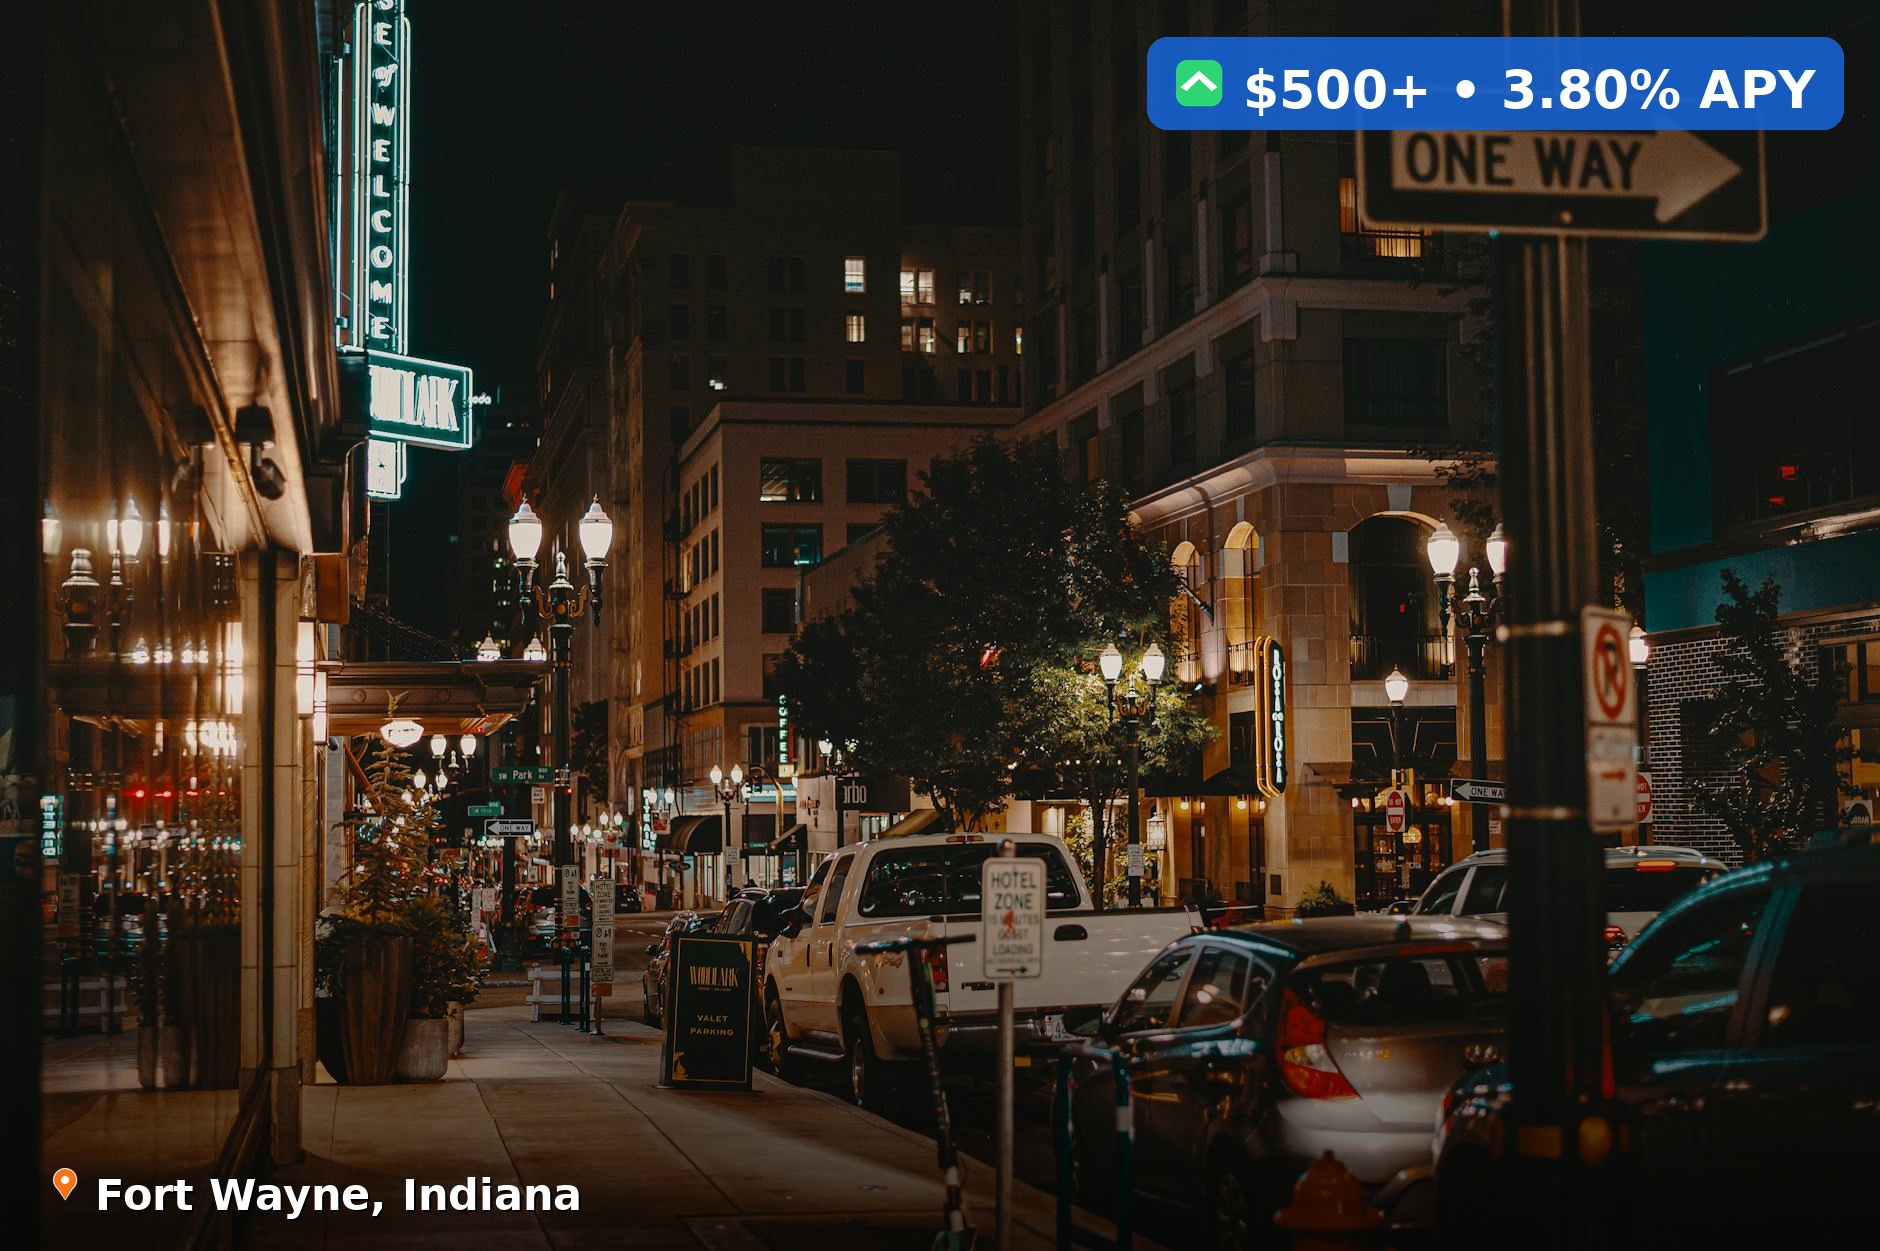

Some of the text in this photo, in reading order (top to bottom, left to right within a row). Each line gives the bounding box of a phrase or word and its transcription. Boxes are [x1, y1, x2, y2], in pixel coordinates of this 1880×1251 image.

[1406, 132, 1643, 190] ONE WAY
[371, 103, 396, 340] WELCOME
[778, 694, 788, 763] COFFEE
[512, 770, 533, 780] Park
[1470, 787, 1505, 799] ONE WA
[500, 823, 529, 832] ONE WAY
[595, 882, 612, 890] HOTEL
[991, 871, 1037, 889] HOTEL
[994, 893, 1033, 910] ZONE
[992, 943, 1034, 956] LOADING
[696, 1014, 729, 1023] VALET
[690, 1027, 735, 1037] PARKING
